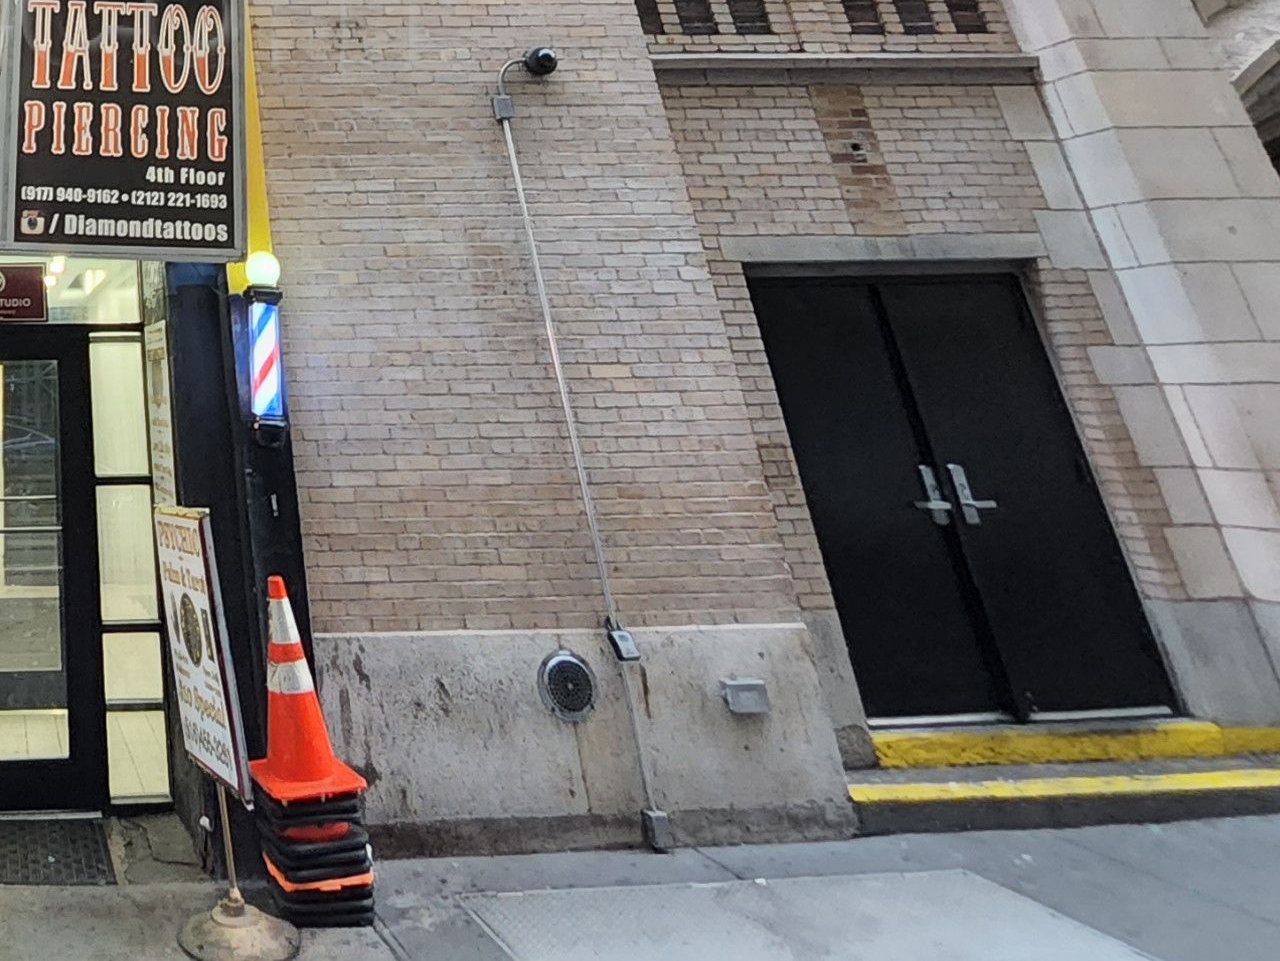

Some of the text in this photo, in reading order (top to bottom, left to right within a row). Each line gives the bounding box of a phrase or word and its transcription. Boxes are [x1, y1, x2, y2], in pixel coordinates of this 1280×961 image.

[21, 99, 228, 162] PIERCING
[145, 165, 226, 186] 4th Floor
[20, 185, 228, 210] (917) 940-9162 (212) 221-1693
[64, 213, 229, 242] Diamondtattoos
